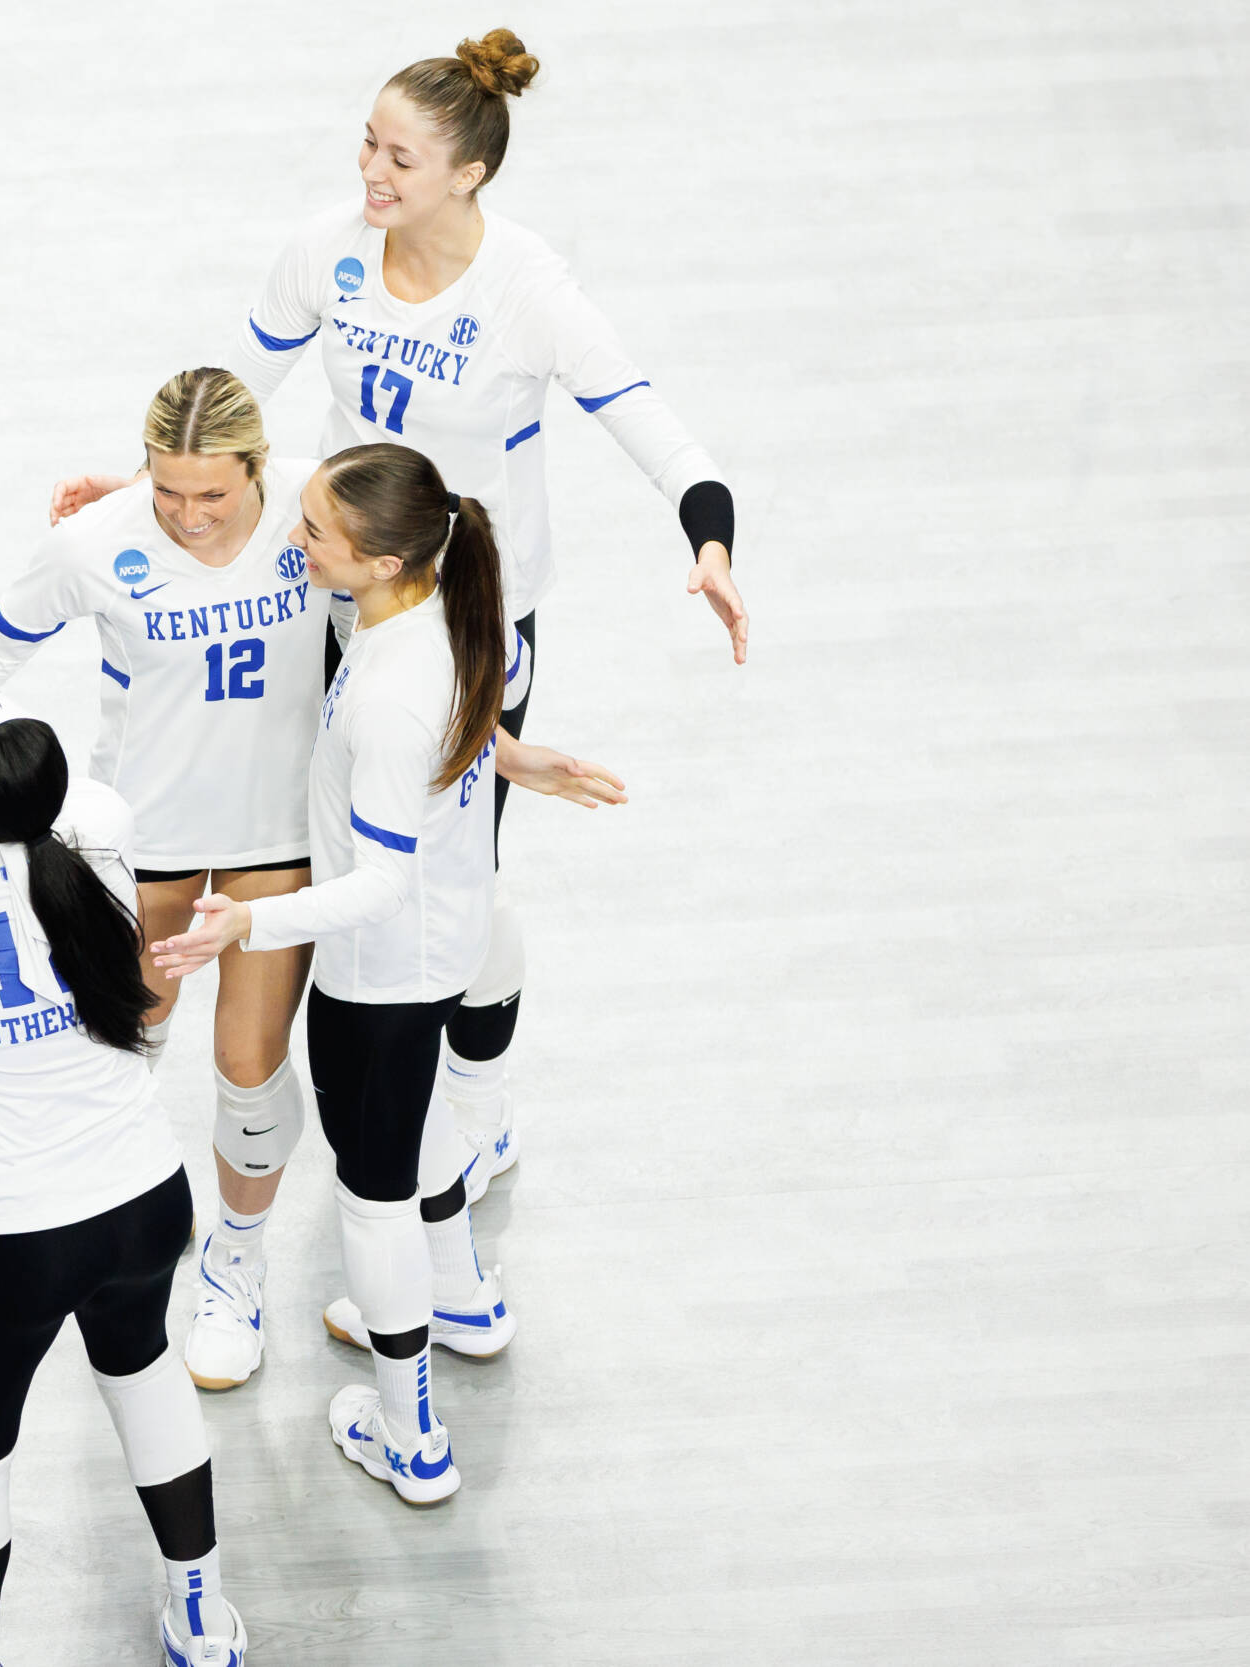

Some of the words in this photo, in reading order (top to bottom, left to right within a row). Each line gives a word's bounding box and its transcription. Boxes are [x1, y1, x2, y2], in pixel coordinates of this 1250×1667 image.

[450, 317, 478, 345] SEC
[360, 364, 414, 435] 17
[119, 564, 149, 577] NCAA
[278, 548, 307, 579] SEC
[144, 581, 309, 640] KENTUCKY
[205, 637, 266, 701] 12
[383, 1444, 410, 1479] UK
